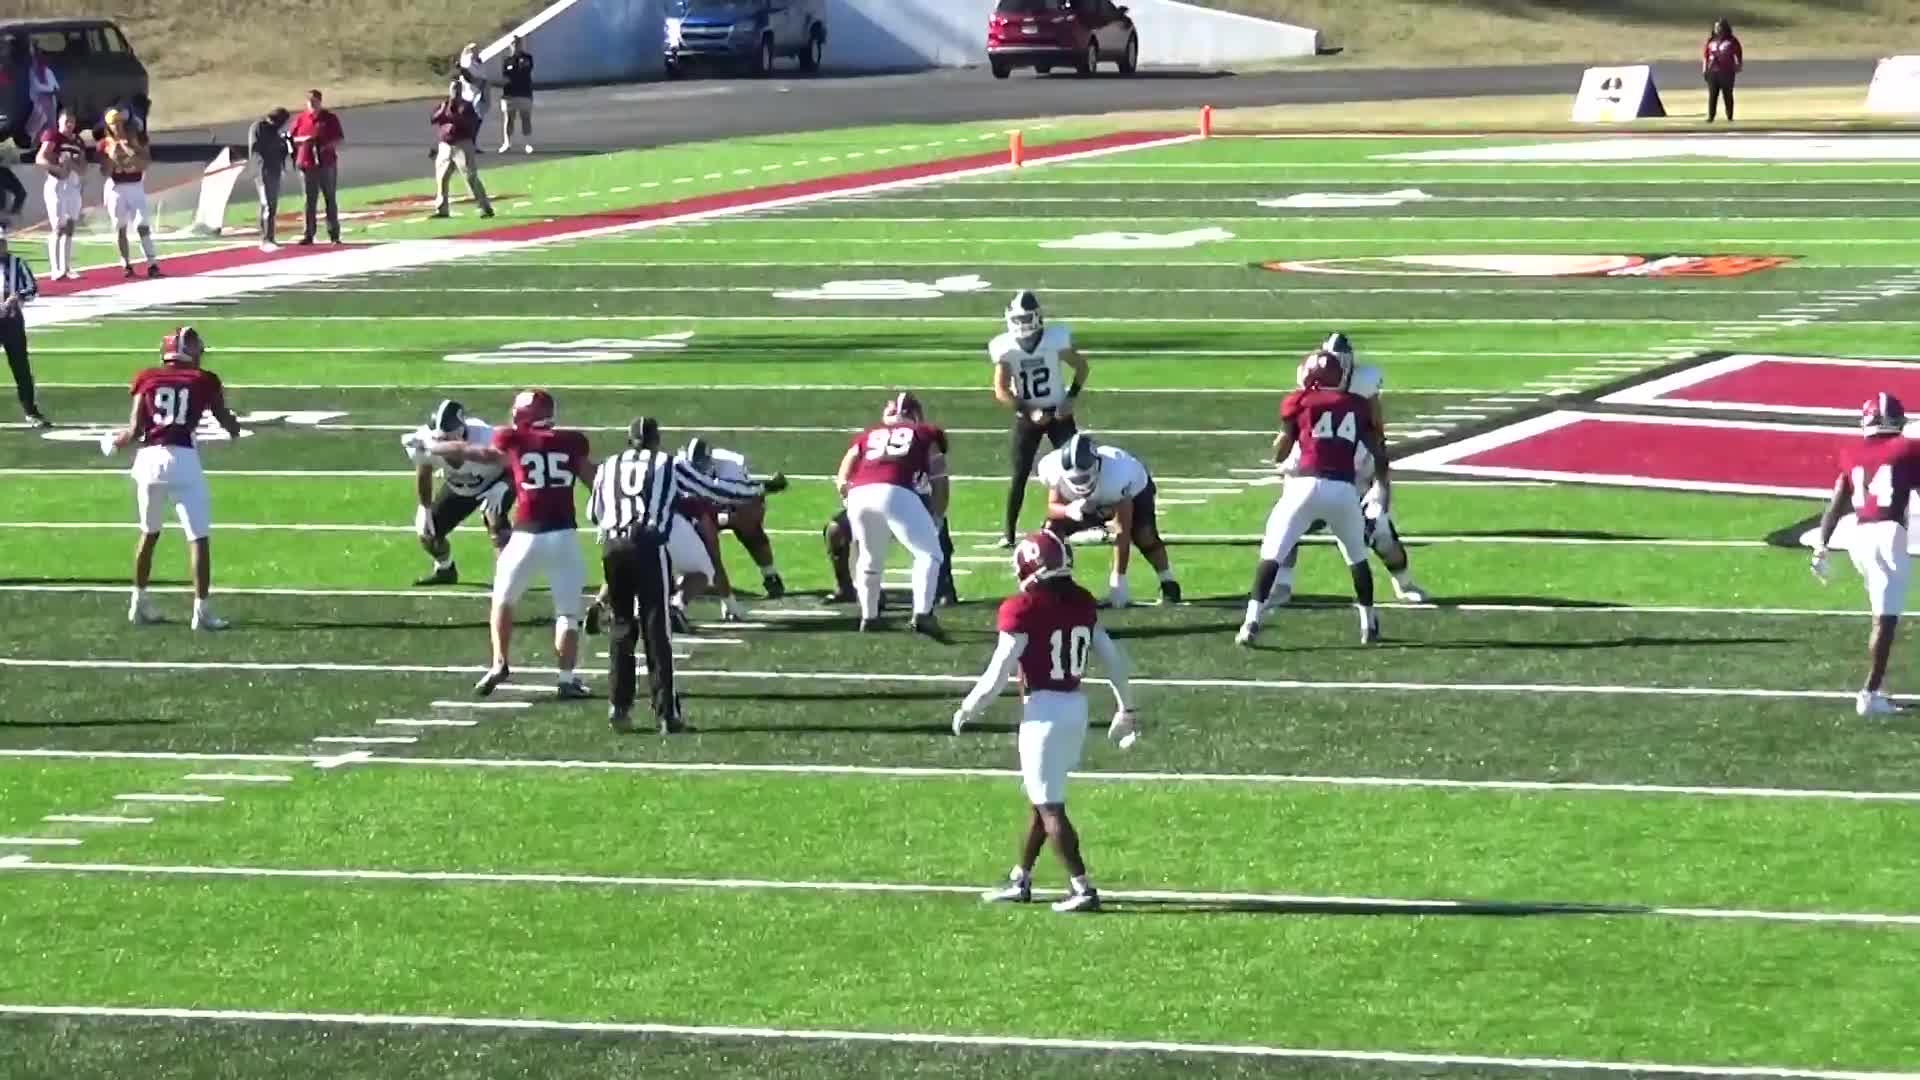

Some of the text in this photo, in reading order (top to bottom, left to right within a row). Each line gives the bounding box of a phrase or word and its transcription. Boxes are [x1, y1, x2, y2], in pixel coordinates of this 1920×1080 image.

[1019, 367, 1051, 400] 12
[153, 386, 189, 425] 91
[866, 426, 915, 461] 99
[1311, 410, 1357, 441] 44
[519, 451, 570, 489] 35
[1850, 463, 1893, 509] 14
[1050, 625, 1091, 680] 10
